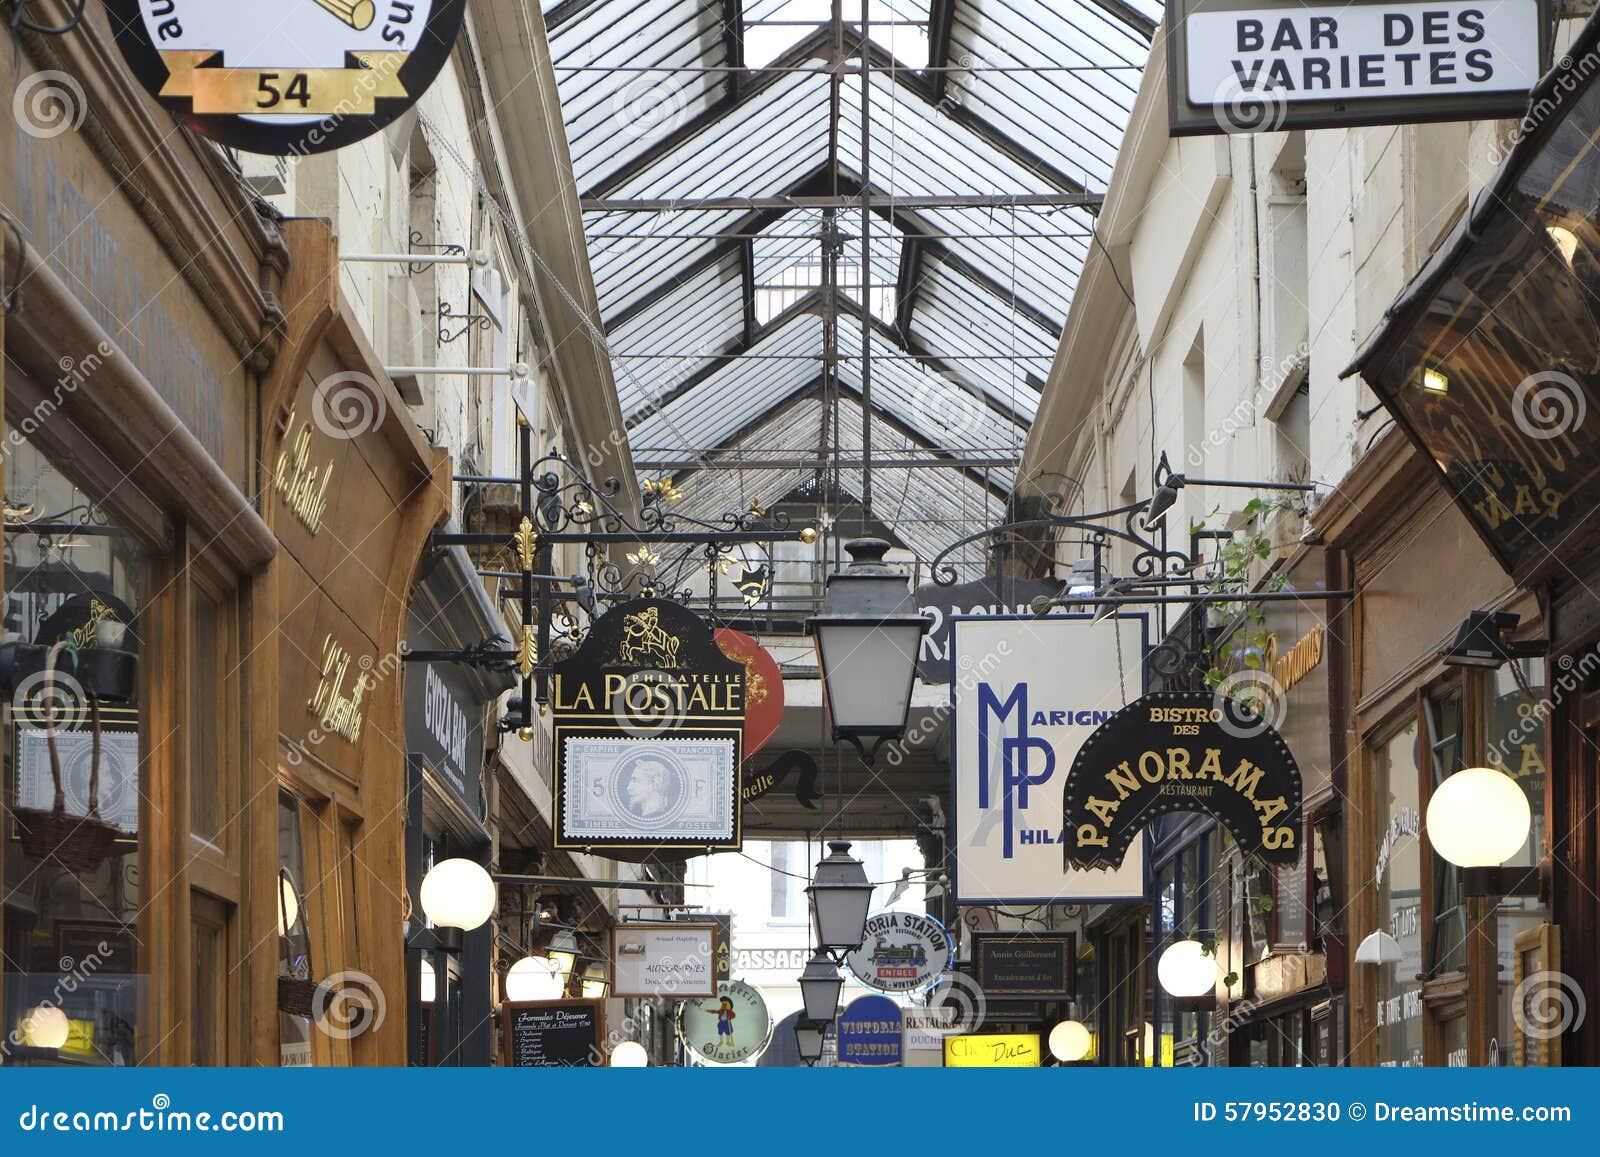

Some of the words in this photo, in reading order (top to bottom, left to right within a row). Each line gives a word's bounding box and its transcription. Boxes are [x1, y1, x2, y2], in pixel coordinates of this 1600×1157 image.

[1236, 18, 1338, 52] BAR
[1384, 9, 1486, 46] DES
[1232, 48, 1495, 92] VARIETES
[256, 73, 311, 108] 54
[632, 674, 741, 683] PHILATELIE
[555, 674, 595, 710] LA
[605, 674, 741, 711] POSTALE
[425, 663, 451, 755] GYOZA
[452, 701, 467, 775] BAR
[1149, 707, 1223, 724] BISTRO
[1173, 725, 1199, 736] DES
[584, 745, 617, 753] EMPIRE
[592, 777, 605, 798] 5
[1160, 784, 1214, 796] RESTAURANT
[1077, 748, 1295, 850] PANORAMAS
[904, 915, 946, 952] STATION
[841, 1022, 902, 1034] VICTORIA
[846, 1043, 899, 1056] STATION
[992, 1042, 1032, 1063] Duc
